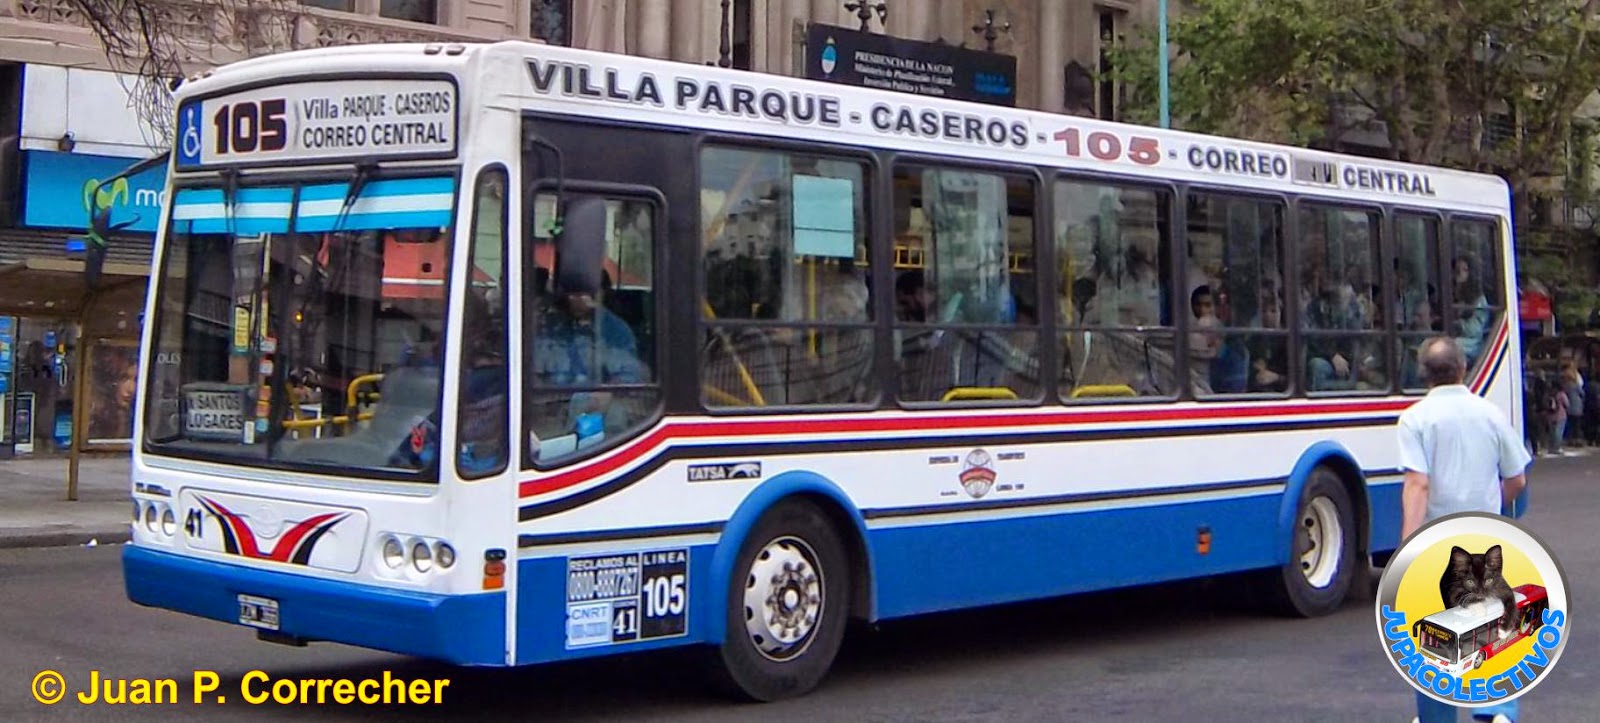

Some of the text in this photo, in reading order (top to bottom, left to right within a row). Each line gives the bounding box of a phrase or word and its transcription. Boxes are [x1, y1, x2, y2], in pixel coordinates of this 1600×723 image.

[303, 98, 338, 120] Villa
[343, 95, 386, 122] PARQUE
[395, 91, 450, 116] CASEROS
[214, 98, 288, 154] 105
[303, 122, 448, 149] CORREO CENTRAL
[525, 57, 663, 107] VILLA
[675, 77, 842, 126] PARQUE
[870, 103, 1028, 149] CASEROS
[1054, 127, 1160, 165] 105
[1187, 144, 1287, 177] CORREO
[1343, 167, 1436, 196] CENTRAL
[198, 394, 240, 410] SANTOS
[189, 413, 243, 430] LUGARES
[687, 466, 726, 480] TATSA
[185, 507, 202, 538] 41
[570, 556, 638, 570] RECLAMOS AL
[643, 552, 686, 566] LINEA
[643, 574, 685, 617] 105
[571, 606, 607, 620] CNRT
[612, 608, 637, 635] 41
